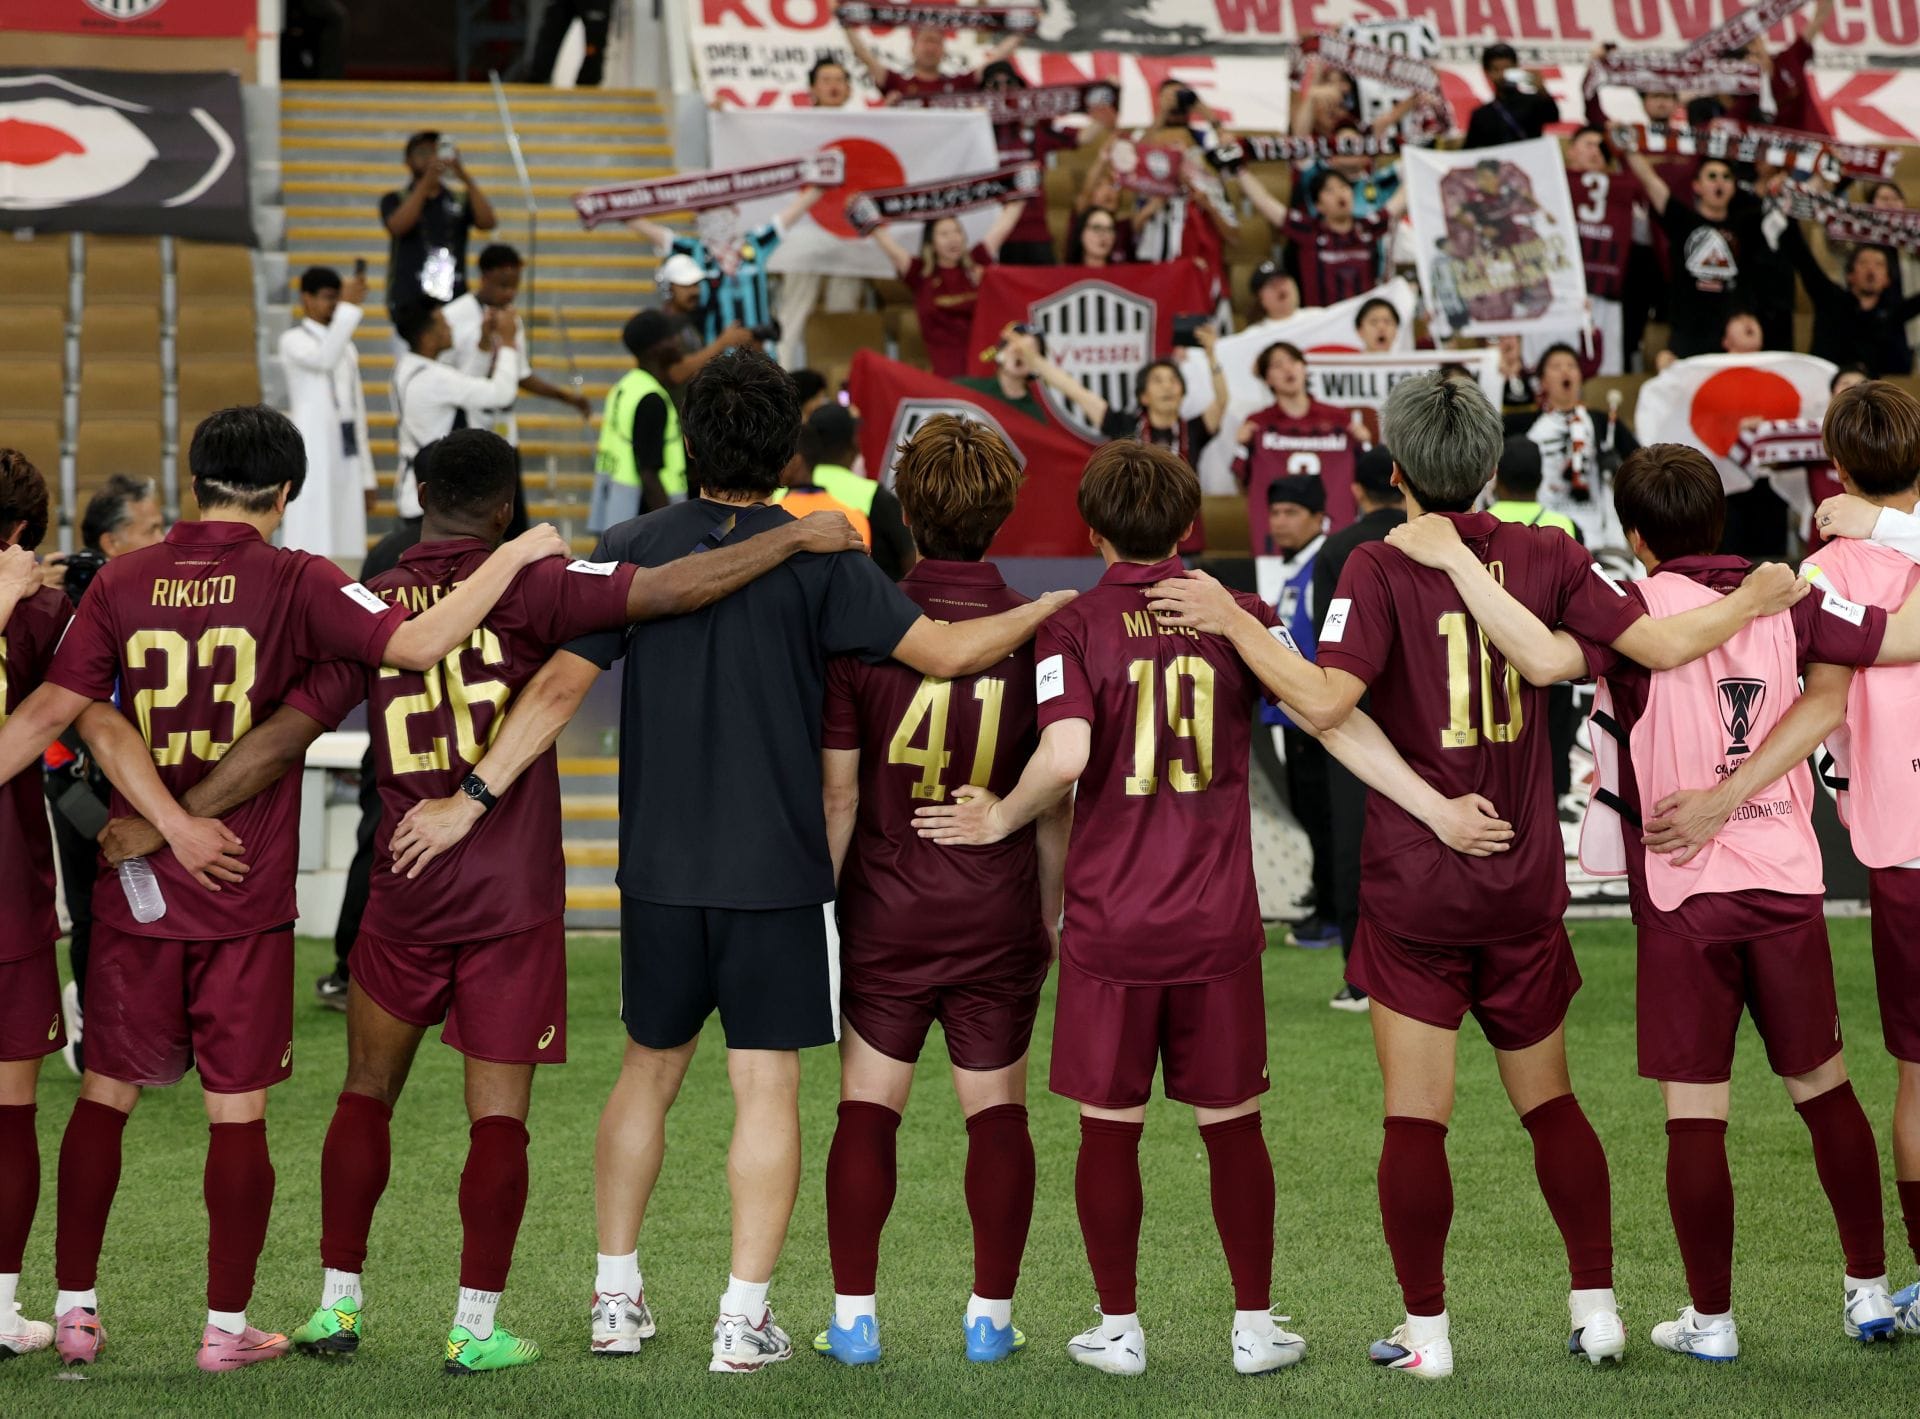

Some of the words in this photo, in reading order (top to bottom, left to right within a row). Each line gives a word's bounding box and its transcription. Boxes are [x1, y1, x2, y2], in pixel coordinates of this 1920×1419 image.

[655, 179, 731, 205] together
[1577, 171, 1610, 224] 3
[1321, 371, 1379, 397] WILL
[151, 574, 236, 609] RIKUTO
[126, 626, 257, 767] 23
[379, 627, 511, 775] 26
[1438, 612, 1524, 748] 10
[887, 675, 1006, 804] 41
[1125, 655, 1216, 796] 19
[1732, 804, 1772, 821] JEDDAH
[458, 1311, 482, 1325] 906
